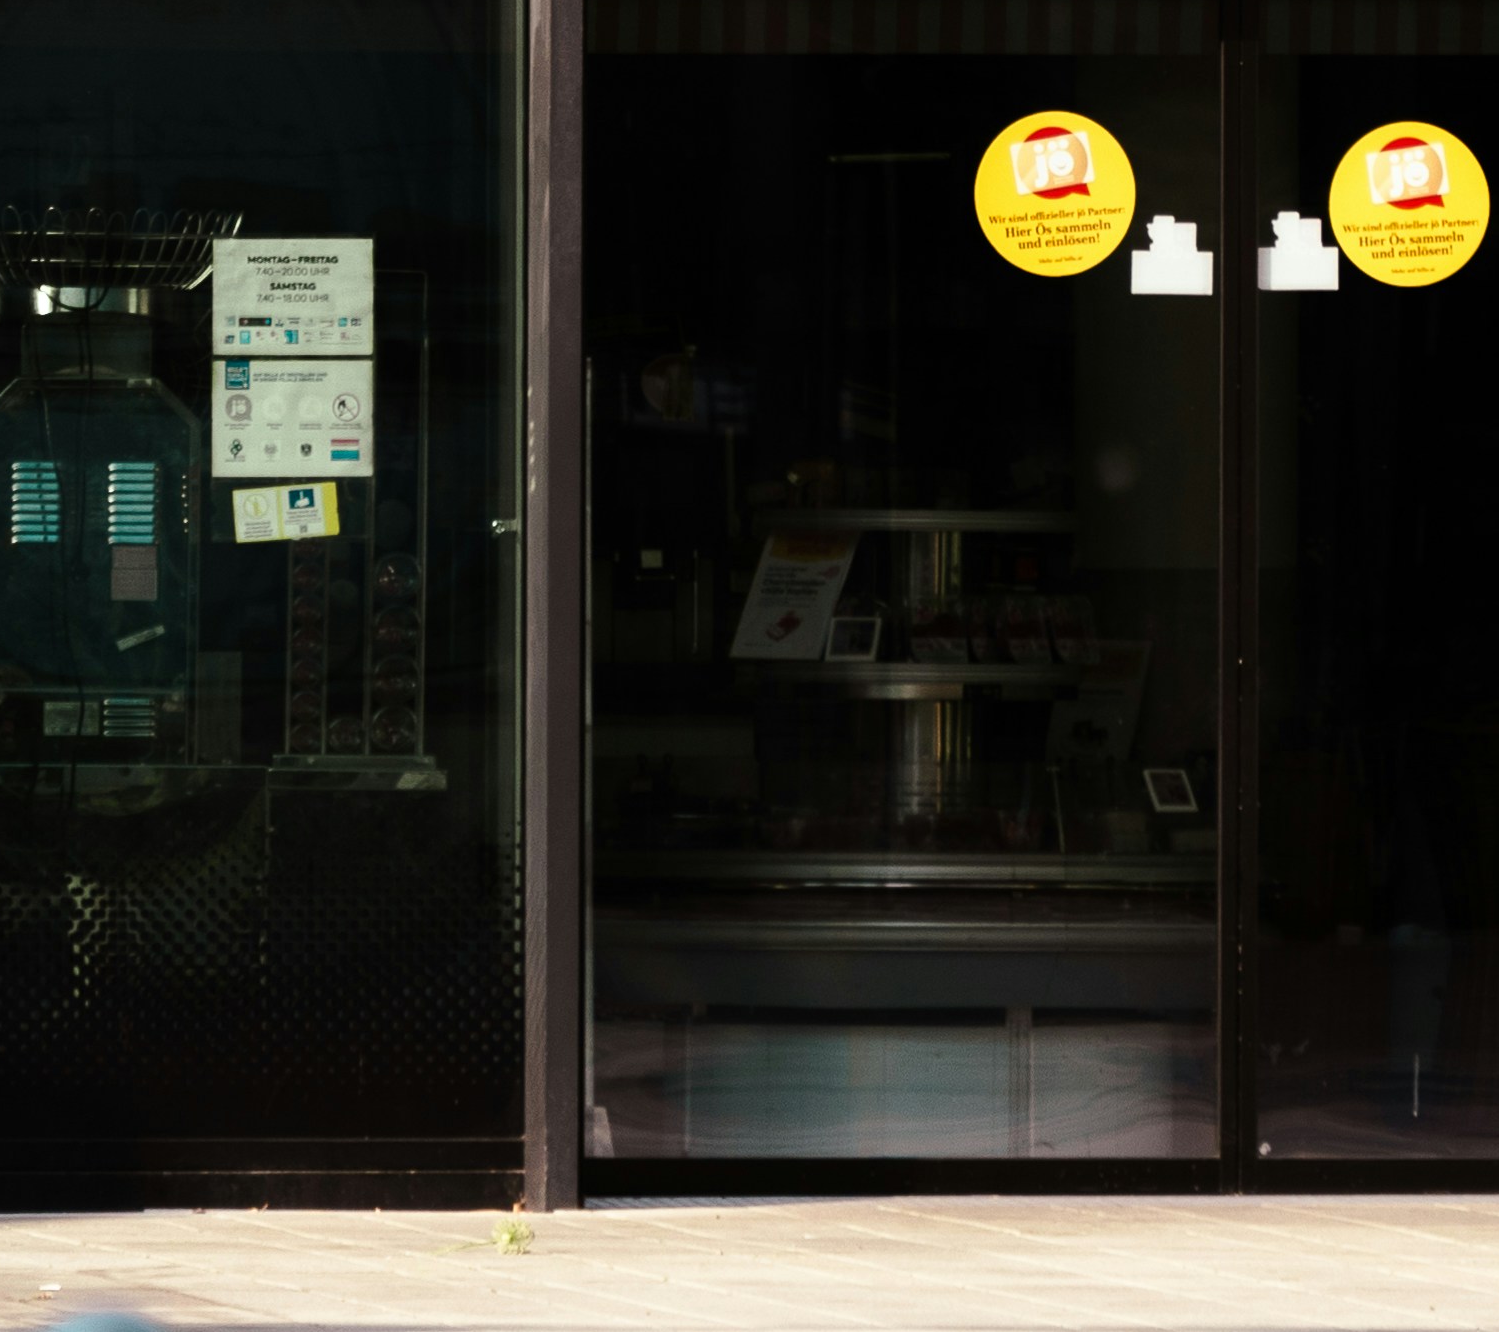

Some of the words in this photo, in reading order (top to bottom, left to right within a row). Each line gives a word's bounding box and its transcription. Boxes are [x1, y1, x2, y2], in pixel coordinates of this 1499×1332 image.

[989, 215, 1006, 224] Wir
[1008, 212, 1028, 223] sind
[1030, 209, 1075, 221] offizieller
[1005, 227, 1031, 239] Hier
[1035, 223, 1053, 235] Ös
[1055, 220, 1111, 234] sammeln
[1362, 222, 1382, 232] sind
[1018, 237, 1042, 250] und
[1045, 233, 1100, 248] einlösen!
[1359, 236, 1386, 247] Hier
[1389, 234, 1406, 245] Ös
[1409, 232, 1464, 245] sammeln
[1371, 248, 1395, 259] und
[1398, 245, 1453, 258] einlösen!
[269, 282, 316, 291] SAMSTAG
